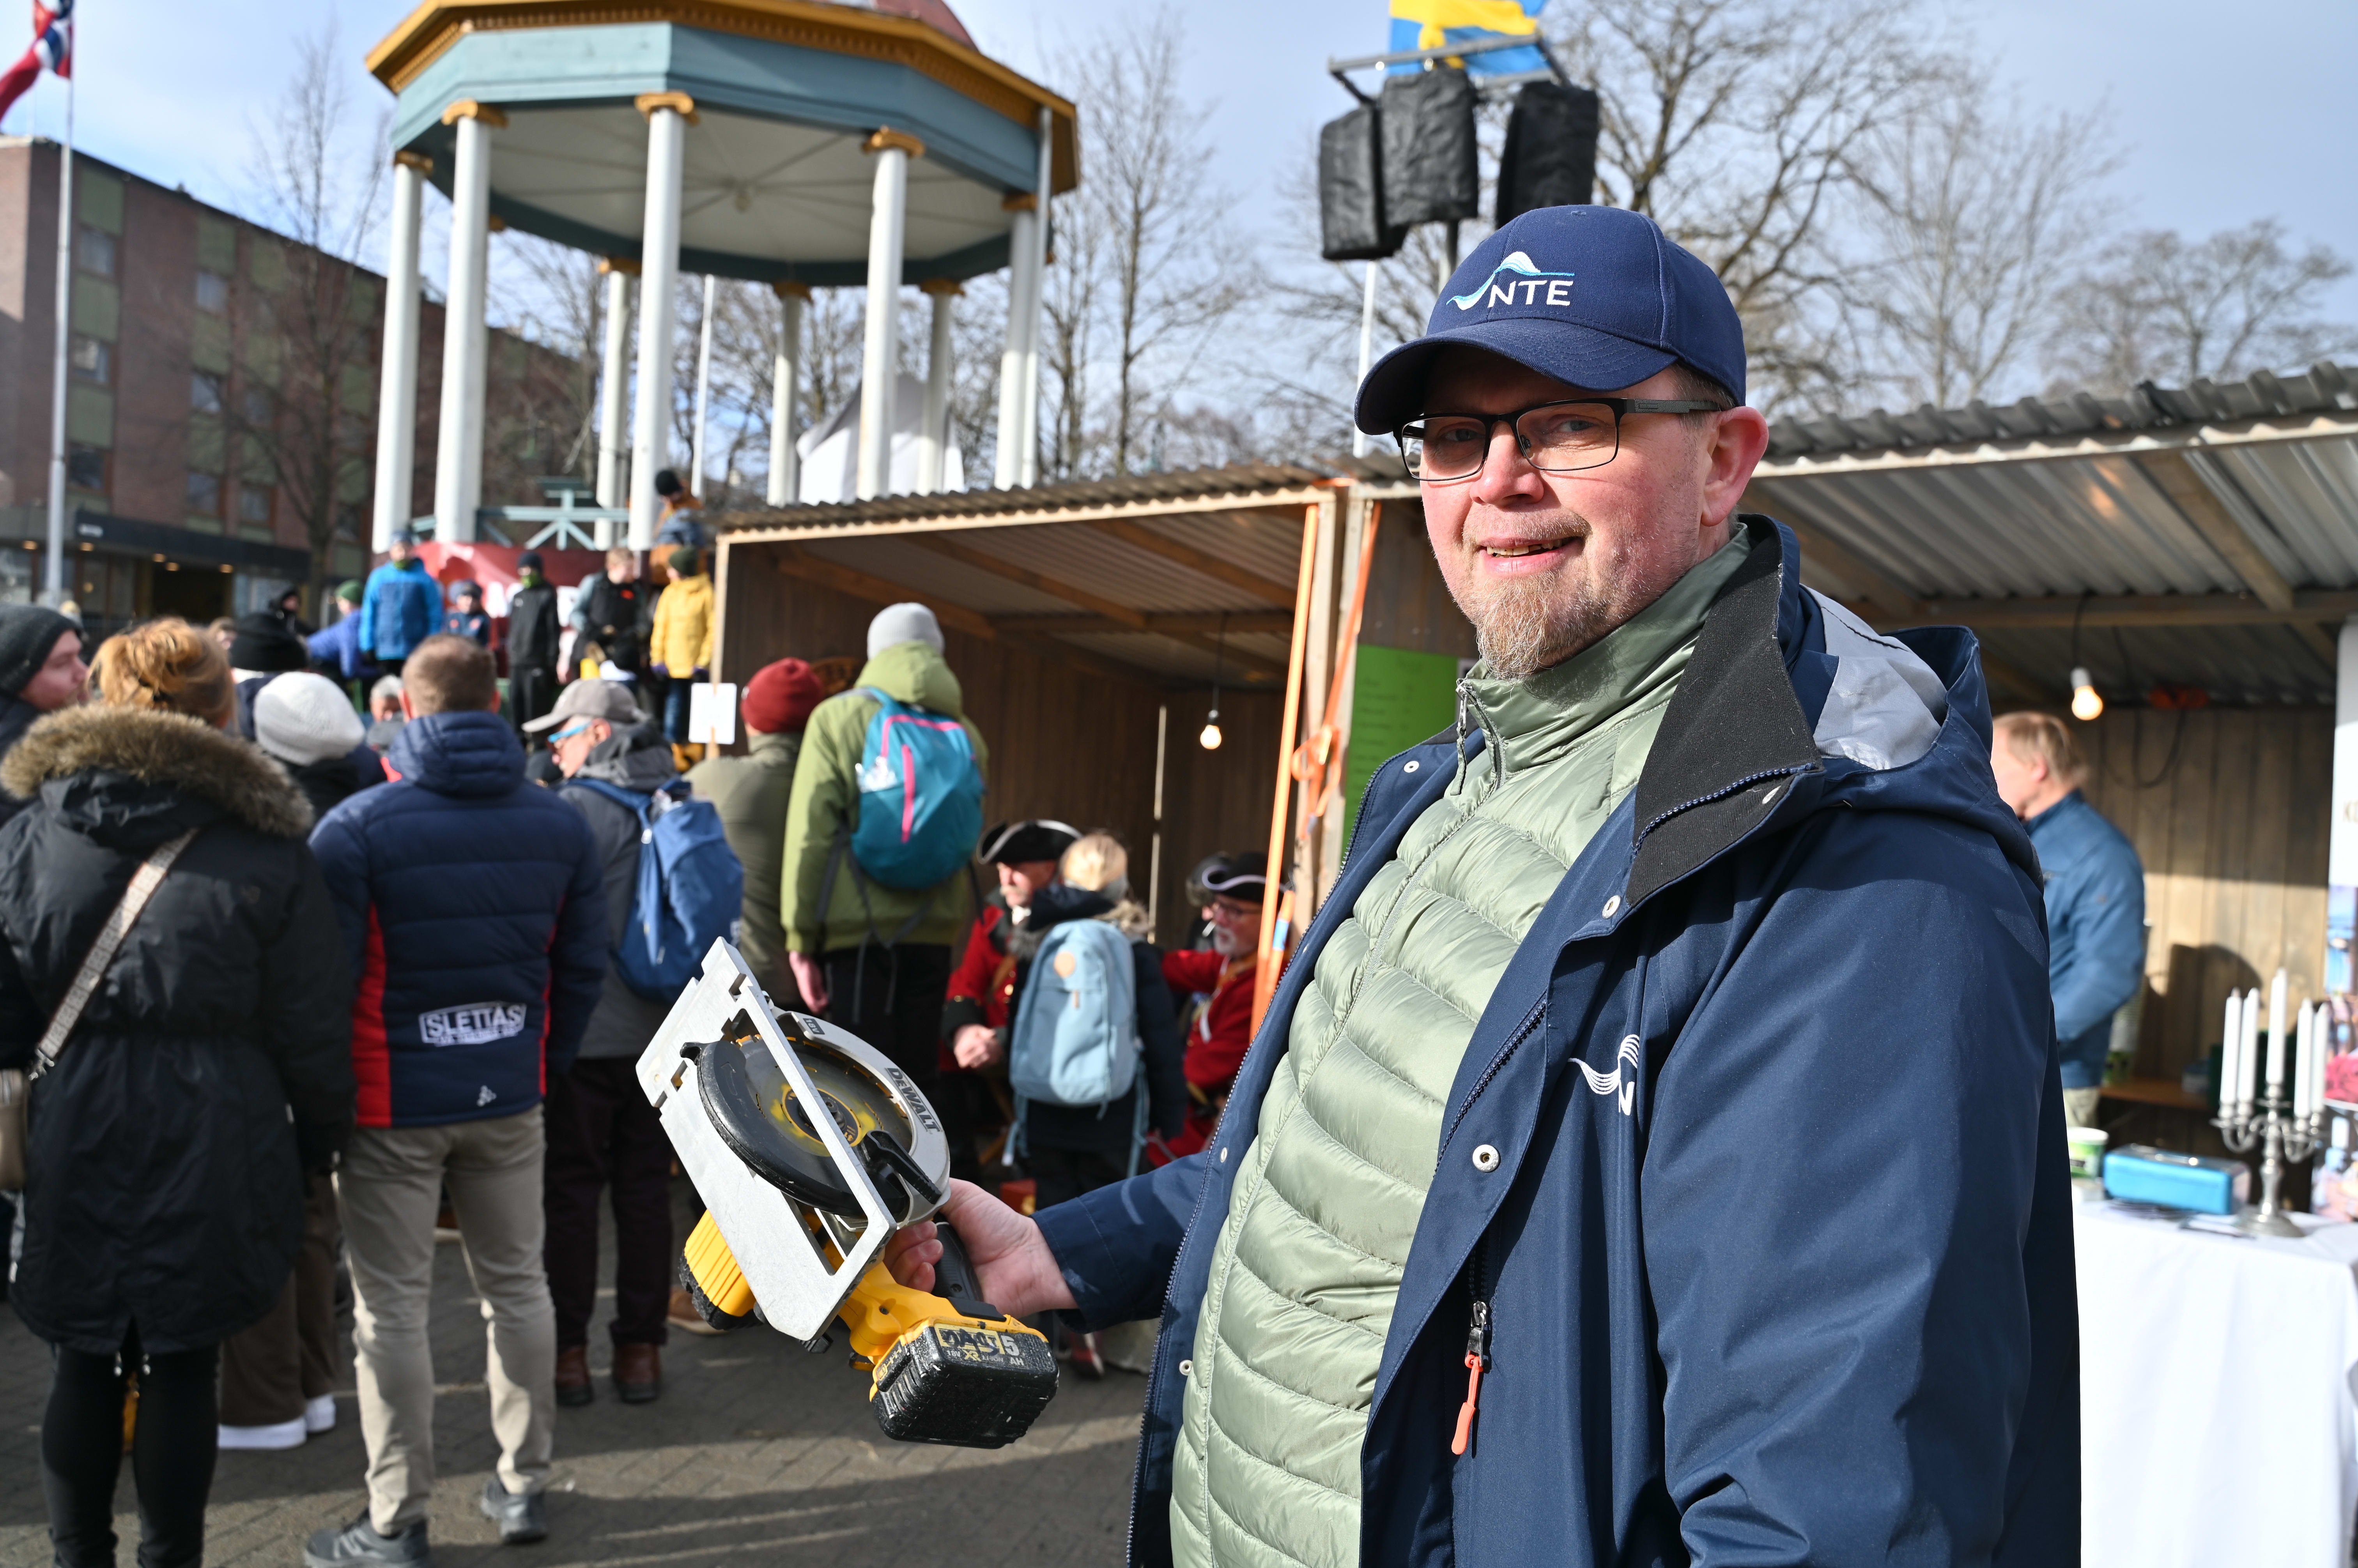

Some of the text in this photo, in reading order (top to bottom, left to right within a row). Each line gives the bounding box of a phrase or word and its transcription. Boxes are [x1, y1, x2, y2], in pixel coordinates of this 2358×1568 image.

[1488, 280, 1574, 308] NTE
[805, 1019, 820, 1032] 18V
[887, 1068, 940, 1131] DEWALT
[1001, 1335, 1019, 1356] 5
[1010, 1357, 1024, 1366] AH
